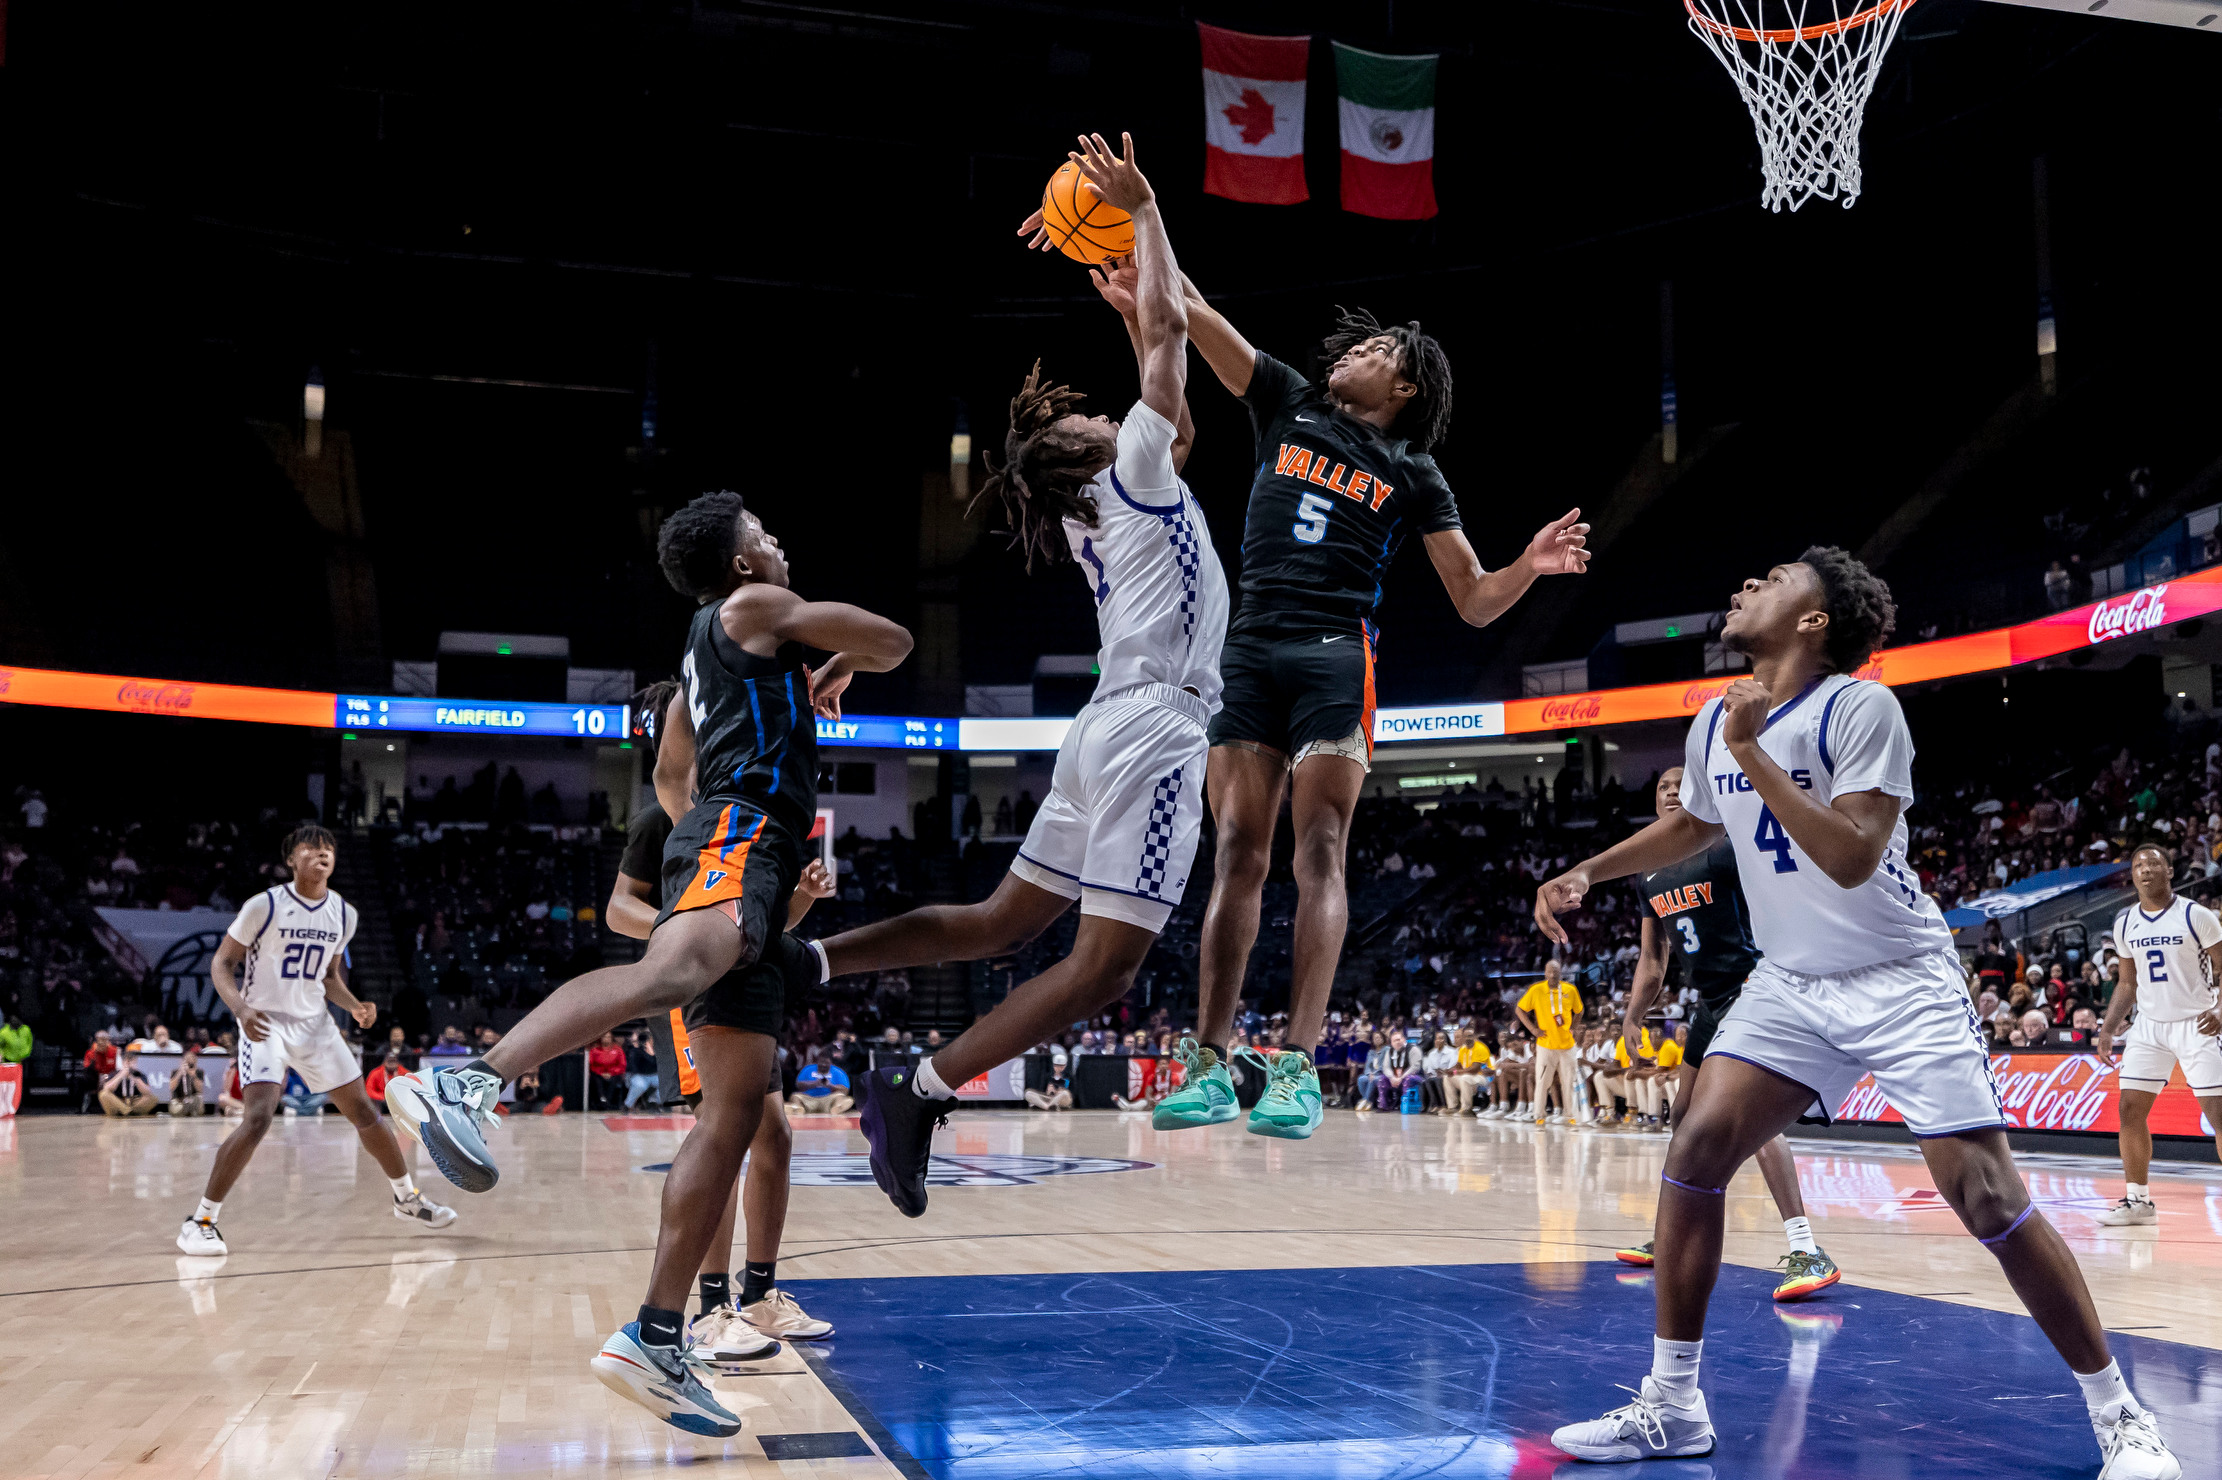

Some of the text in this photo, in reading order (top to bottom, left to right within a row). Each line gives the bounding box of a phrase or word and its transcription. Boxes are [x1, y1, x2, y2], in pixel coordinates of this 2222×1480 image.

[1275, 443, 1395, 513] VALLEY
[1292, 491, 1335, 544] 5
[2088, 584, 2169, 644] Coca-Cola
[436, 708, 527, 728] FAIRFIELD
[572, 709, 606, 735] 10
[816, 722, 859, 739] LLEY
[1382, 714, 1484, 733] POWERADE
[1714, 769, 1813, 795] TIGS
[1754, 801, 1799, 875] 4
[1650, 882, 1714, 918] VALLEY
[278, 928, 339, 943] TIGERS
[1676, 916, 1701, 954] 3
[2128, 935, 2184, 949] TIGERS
[281, 943, 325, 980] 20
[2146, 949, 2169, 983] 2
